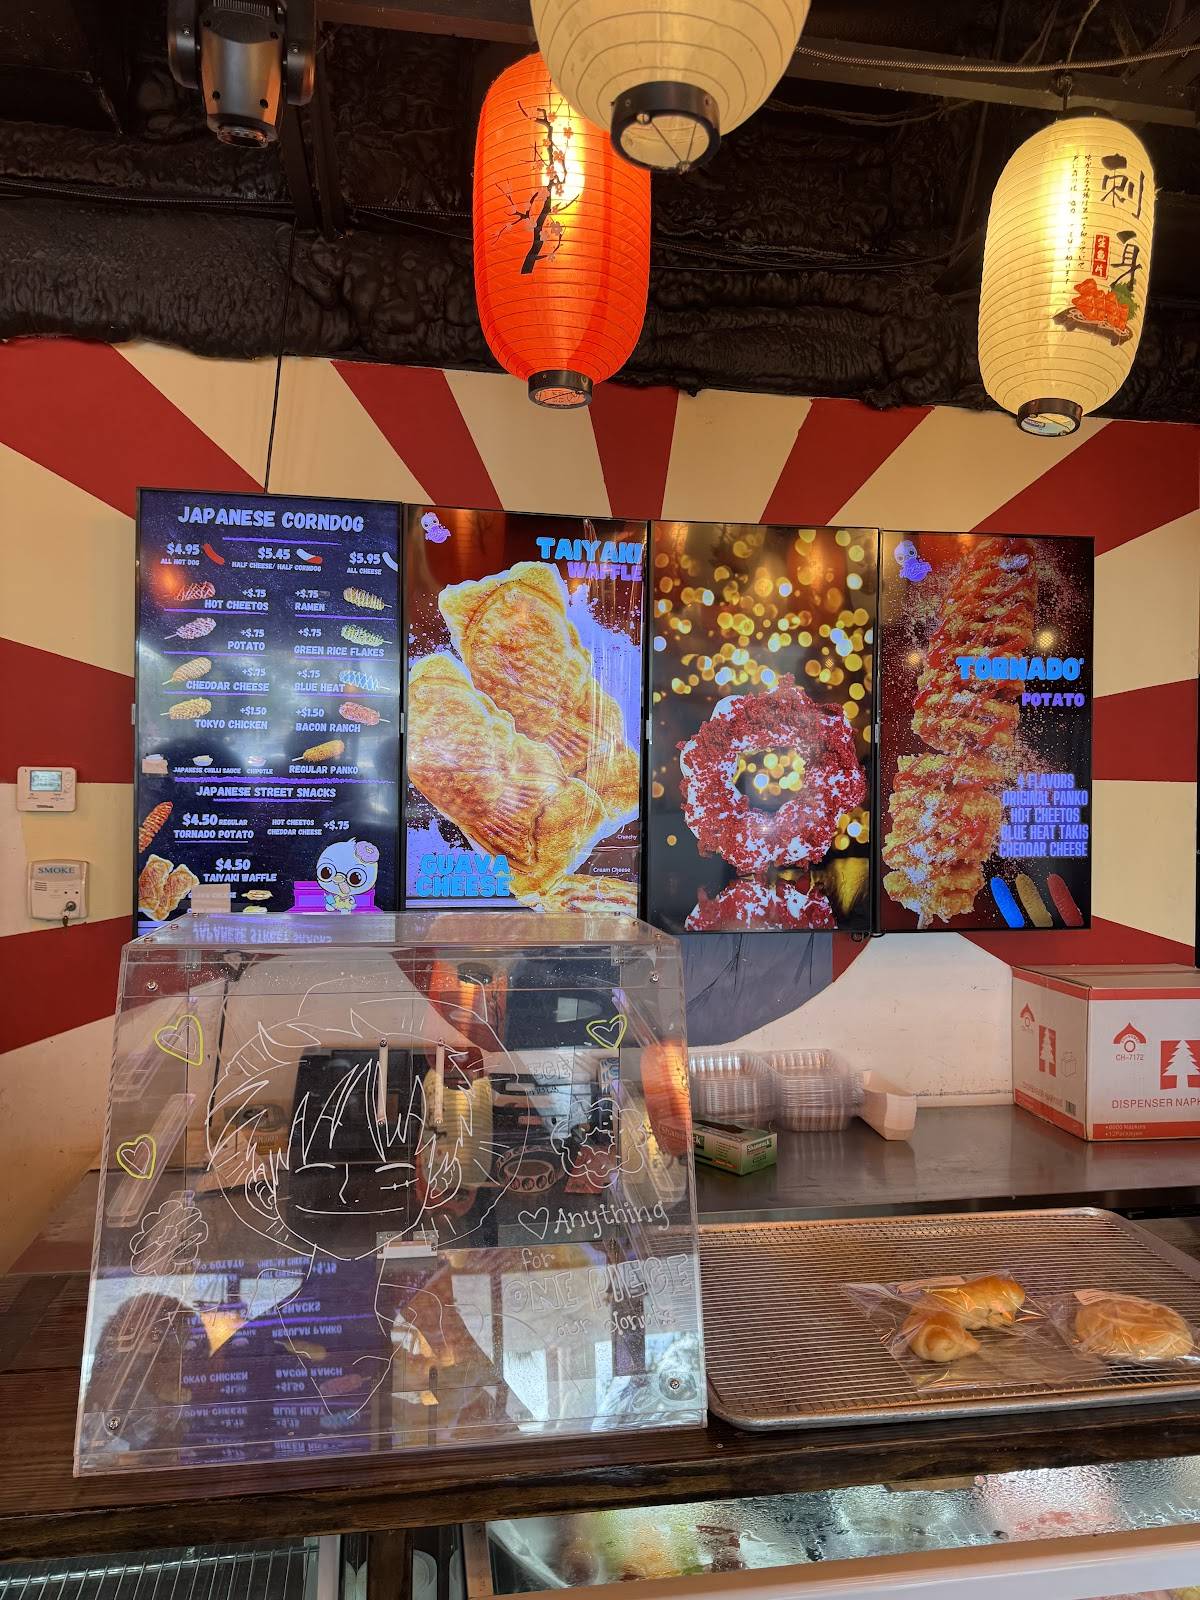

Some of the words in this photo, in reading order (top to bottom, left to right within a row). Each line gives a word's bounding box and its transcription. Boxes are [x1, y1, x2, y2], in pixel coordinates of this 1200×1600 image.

[1101, 154, 1145, 291] 刺身
[178, 506, 275, 527] JAPANESE
[282, 511, 364, 532] CORNDOG
[167, 542, 200, 556] $4.95
[258, 547, 290, 560] $5.45
[537, 537, 642, 563] TAIYAKI
[349, 551, 380, 565] $5.95
[277, 563, 293, 571] HALF
[294, 564, 321, 572] CORNDOG
[567, 561, 642, 581] WAFFLE
[242, 588, 266, 598] +$.75
[295, 588, 318, 598] +$.75
[204, 599, 223, 609] HOT
[226, 600, 269, 611] CHEETOS
[295, 602, 325, 612] RAMEN
[240, 628, 264, 638] +$.75
[298, 628, 321, 638] +$.75
[227, 641, 265, 651] POTATO
[294, 646, 325, 655] GREEN
[327, 646, 347, 656] RICE
[350, 647, 384, 657] FLAKES
[242, 667, 266, 677] +$.75
[296, 670, 320, 679] +$.75
[186, 681, 231, 691] CHEDDAR
[233, 682, 269, 692] CHEESE
[294, 682, 318, 692] BLUE
[320, 683, 345, 692] HEAT
[1022, 692, 1085, 707] POTATO
[240, 706, 267, 716] +$1.50
[295, 708, 324, 718] +$1.50
[195, 719, 226, 729] TOKYO
[228, 720, 268, 730] CHICKEN
[295, 722, 327, 732] BACON
[330, 723, 361, 733] RANCH
[289, 765, 327, 774] REGULAR
[330, 766, 358, 775] PANKO
[1029, 773, 1074, 788] FLAVORS
[196, 786, 251, 797] JAPANESE
[254, 787, 294, 797] STREET
[297, 787, 336, 798] SNACKS
[1002, 791, 1050, 805] ORIGINAL
[1054, 791, 1088, 805] PANKO
[182, 813, 218, 826] $4.50
[1011, 808, 1031, 823] HOT
[1035, 808, 1080, 822] CHEETOS
[323, 820, 350, 830] +$.75
[173, 829, 216, 839] TORNADO
[218, 830, 254, 839] POTATO
[267, 828, 297, 836] CHEDDAR
[1001, 825, 1027, 840] BLUE
[1030, 825, 1055, 839] HEAT
[1059, 825, 1089, 839] TAKIS
[1000, 842, 1047, 857] CHEDDAR
[1050, 842, 1088, 856] CHEESE
[215, 858, 250, 871] $4.50
[420, 854, 510, 874] GUAVA
[203, 873, 239, 882] TAIYAKI
[242, 873, 277, 882] WAFFLE
[416, 875, 510, 897] CHEESE
[1112, 1099, 1173, 1109] DISPENSER
[554, 1201, 670, 1238] Anything
[505, 1272, 579, 1313] ONE
[588, 1253, 693, 1312] PIECE
